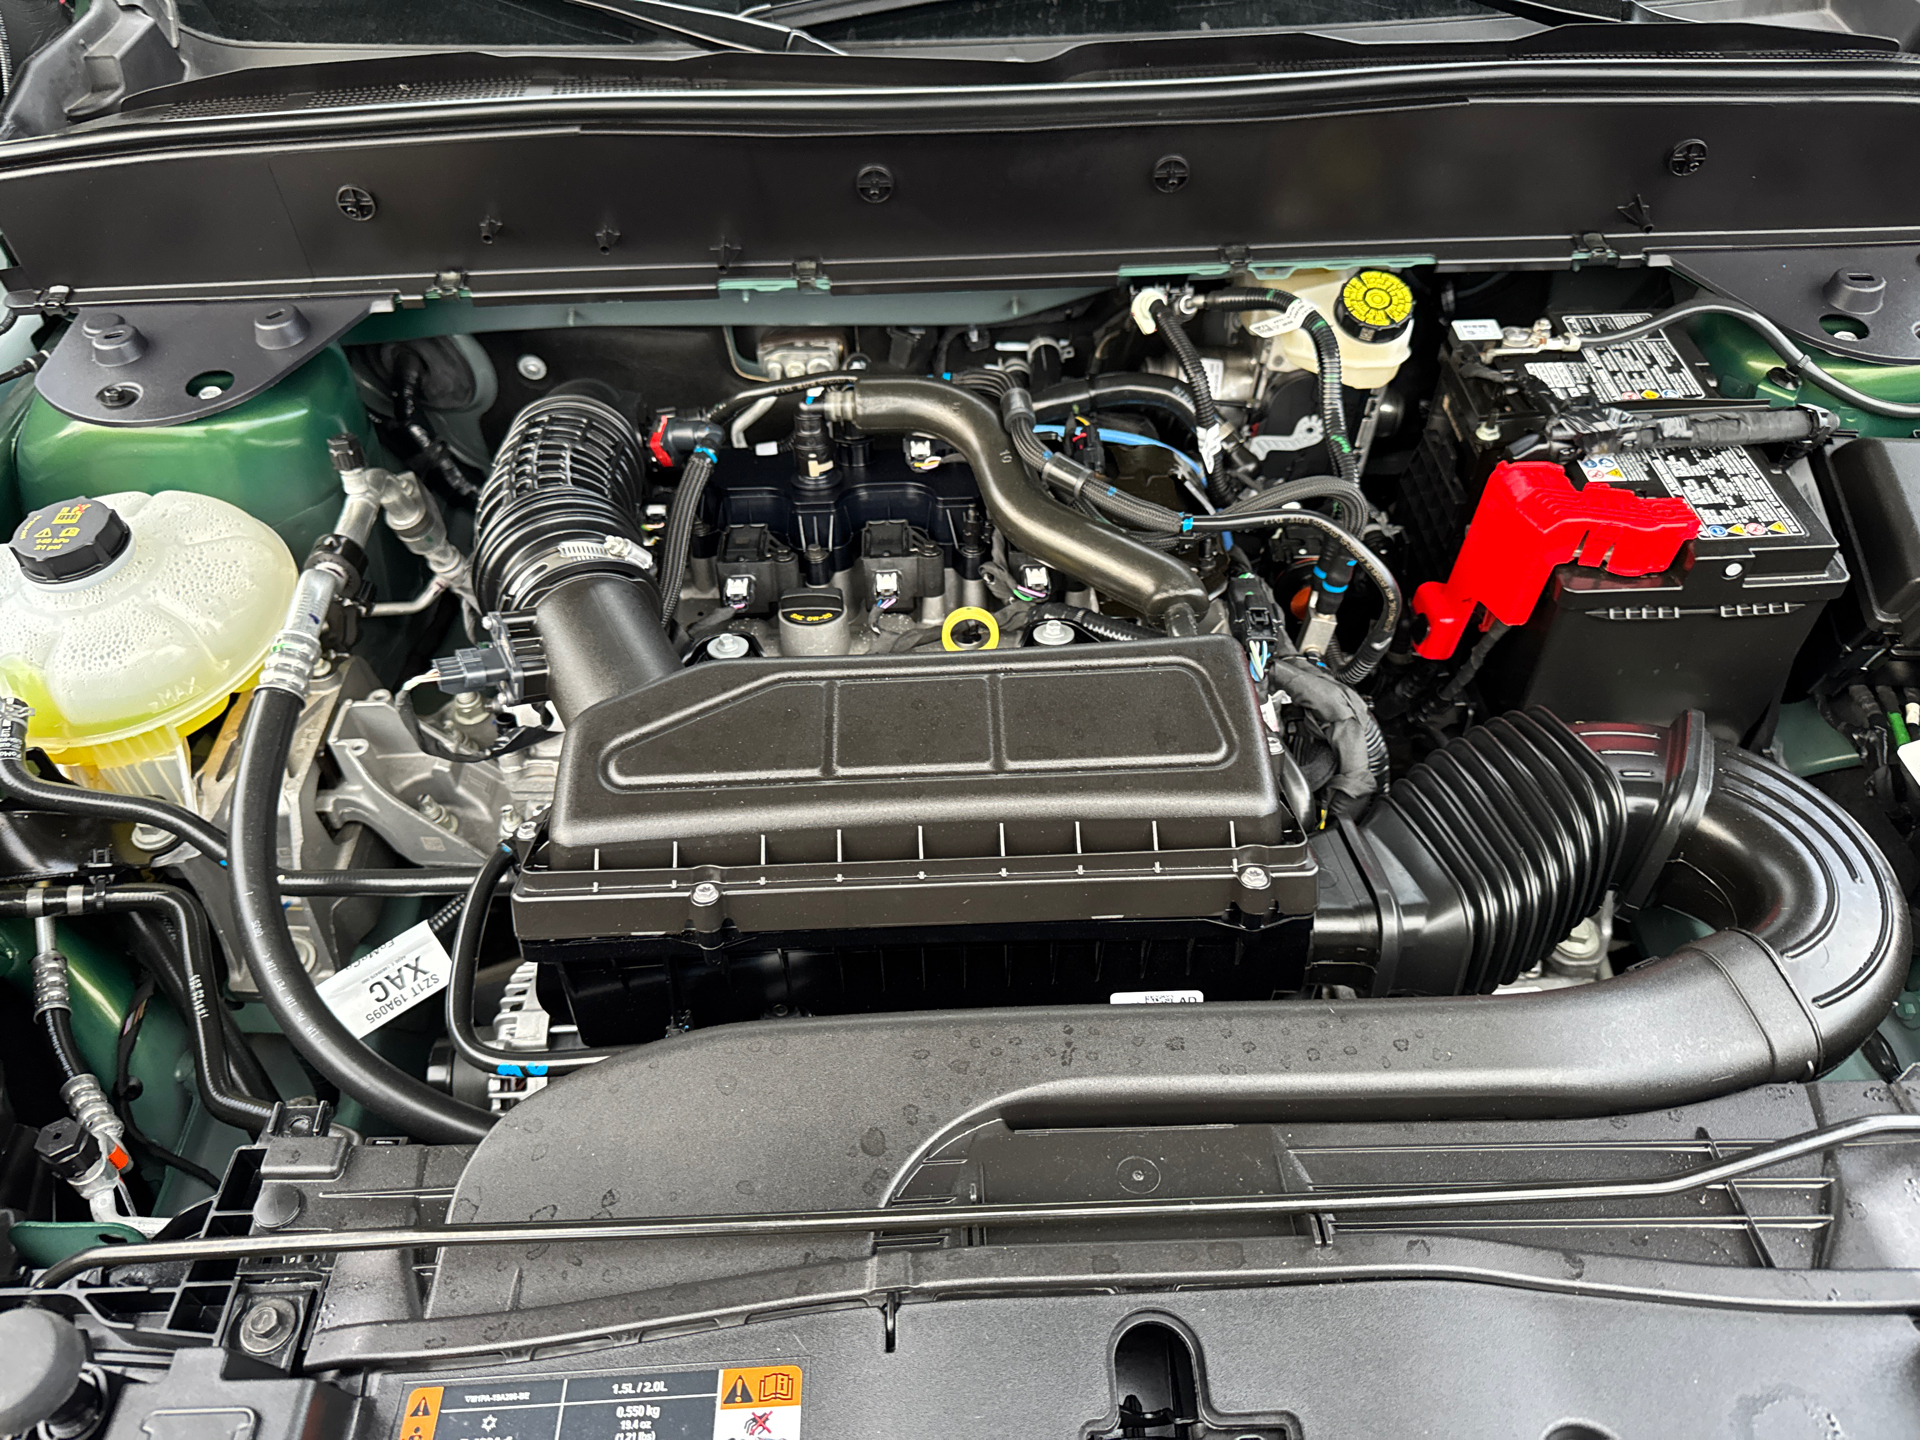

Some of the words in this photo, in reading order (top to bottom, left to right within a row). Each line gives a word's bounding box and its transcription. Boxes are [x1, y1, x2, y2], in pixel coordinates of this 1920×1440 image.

[157, 676, 204, 706] MAX
[368, 955, 430, 1003] XAC
[410, 974, 440, 998] SZ1T
[365, 994, 408, 1024] 19A095
[612, 1383, 636, 1394] 1.5L
[642, 1381, 668, 1393] 2.0L
[616, 1404, 645, 1418] 0.550
[646, 1404, 660, 1418] kg
[620, 1420, 639, 1430] 19.4
[640, 1420, 652, 1429] oz
